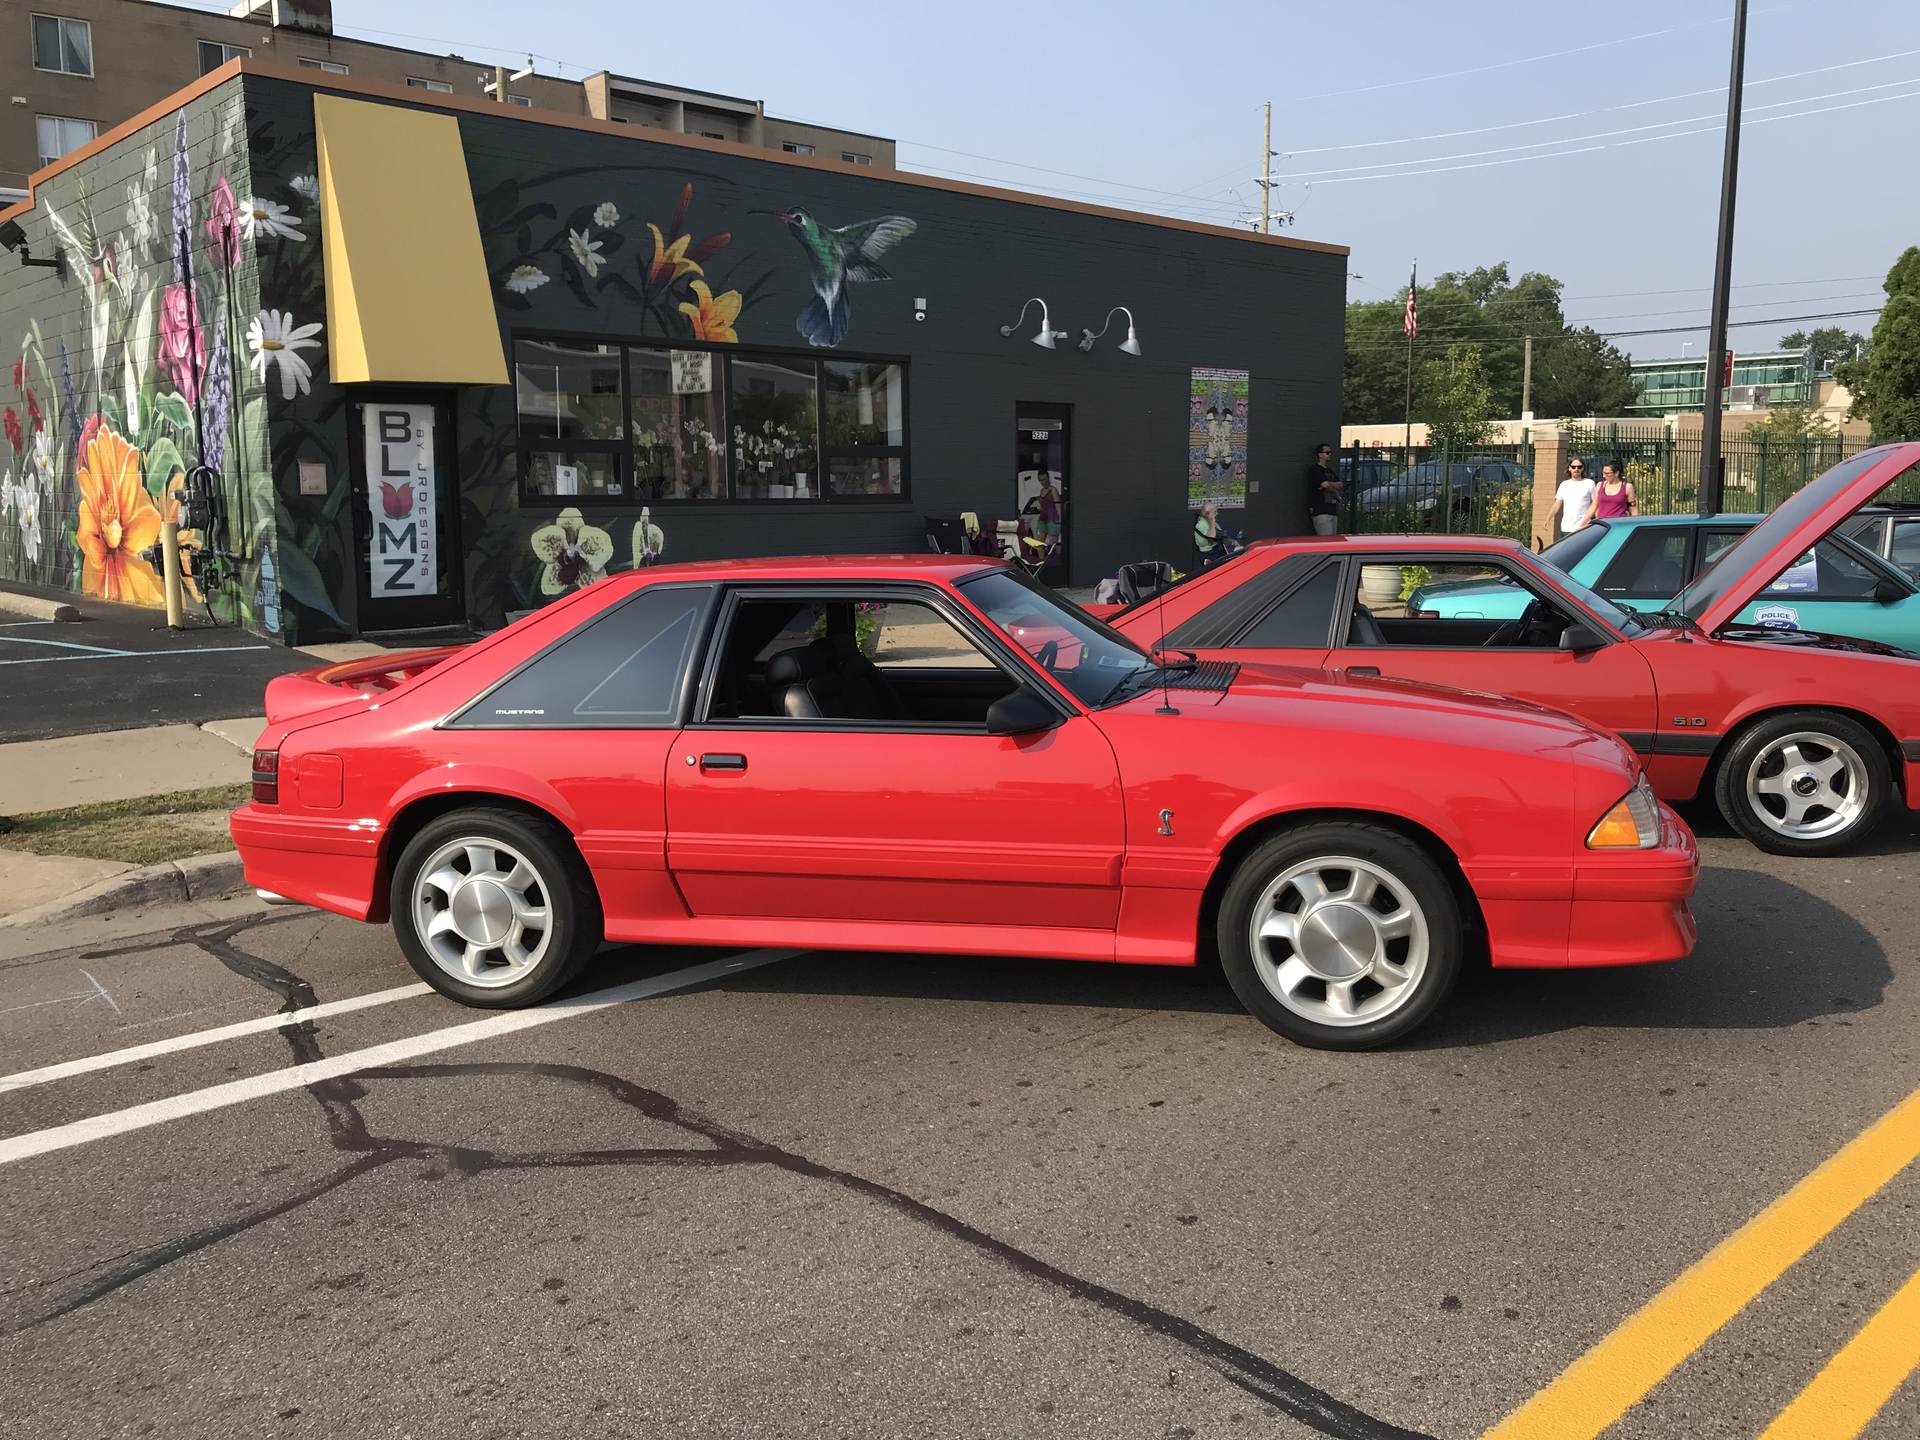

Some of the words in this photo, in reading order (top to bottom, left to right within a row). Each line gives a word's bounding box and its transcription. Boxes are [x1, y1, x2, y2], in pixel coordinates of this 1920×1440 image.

[416, 429, 425, 450] BY
[417, 463, 429, 577] JRDESIGNS
[1761, 612, 1791, 620] POLICE
[1674, 716, 1706, 727] 5.0
